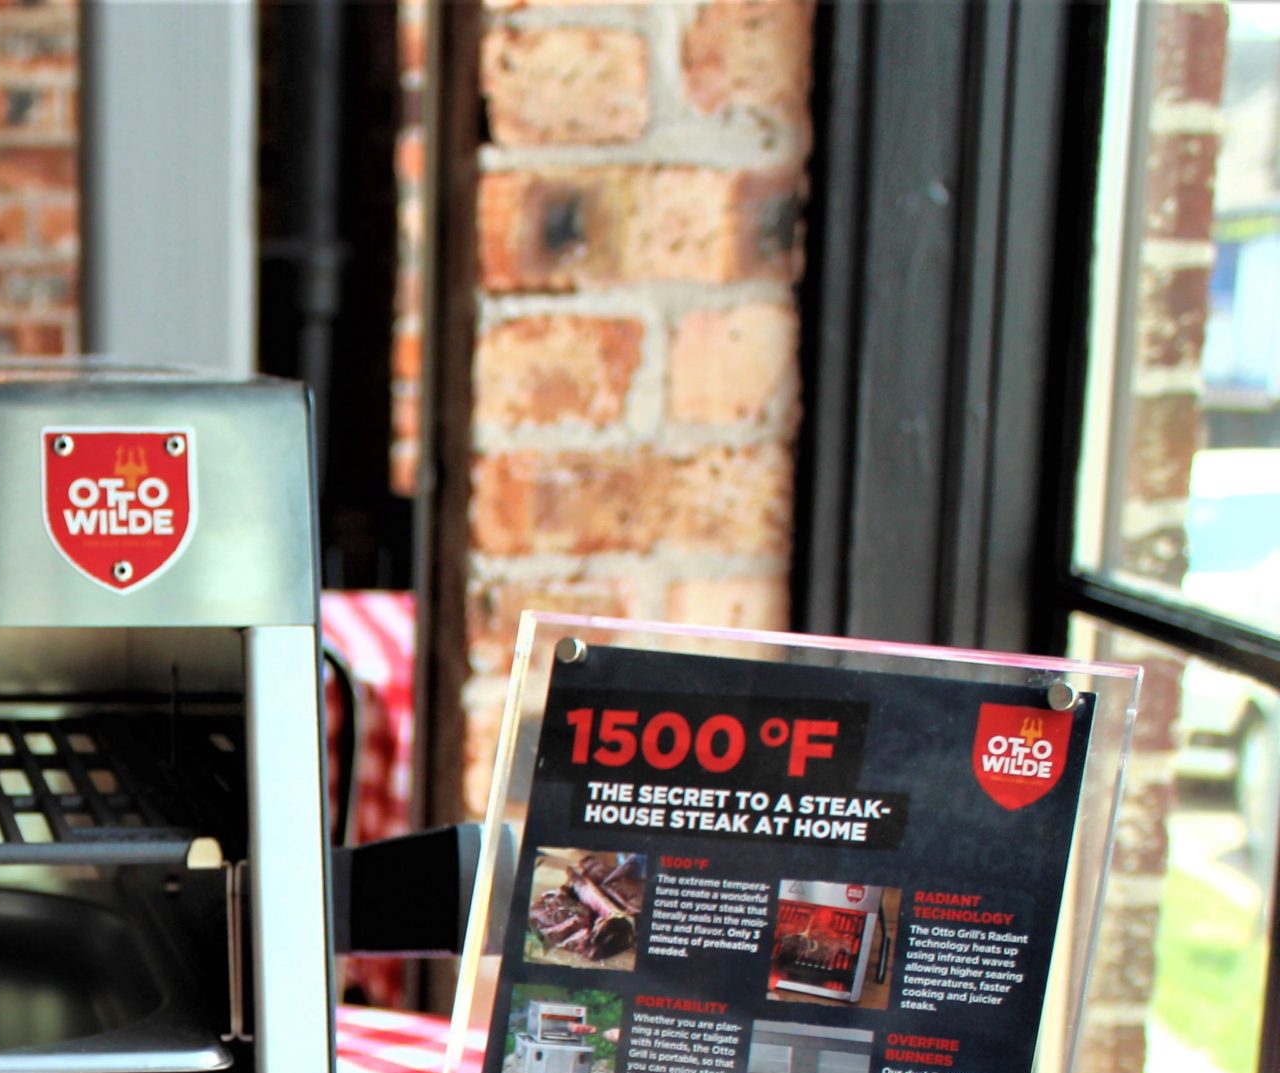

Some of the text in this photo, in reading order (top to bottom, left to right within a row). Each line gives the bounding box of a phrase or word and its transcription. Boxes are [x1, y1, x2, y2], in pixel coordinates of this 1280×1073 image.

[68, 477, 169, 520] OTTO
[63, 509, 174, 535] WILDE
[567, 708, 746, 773] 1500
[987, 735, 1053, 766] OTTO
[982, 755, 1053, 778] WILDE
[588, 782, 892, 819] THE SECRET TO A STEAK-
[584, 804, 868, 842] HOUSE STEAK AT HOME
[657, 873, 770, 891] The extreme tempera-
[656, 886, 679, 896] tures
[681, 888, 710, 898] create
[720, 892, 768, 903] wonderful
[915, 891, 981, 906] RADIANT
[654, 899, 678, 908] crust
[694, 903, 717, 912] your
[719, 904, 744, 914] steak
[747, 906, 768, 916] that
[913, 906, 1014, 925] TECHNOLOGY
[652, 910, 687, 922] literally
[688, 914, 711, 923] seals
[713, 915, 722, 924] in
[724, 916, 739, 925] the
[651, 922, 671, 932] ture
[673, 924, 692, 933] and
[727, 928, 751, 940] Only
[752, 930, 760, 939] 3
[910, 925, 929, 935] The
[931, 927, 955, 937] Otto
[988, 932, 1028, 943] Radiant
[648, 946, 688, 957] needed.
[650, 934, 758, 952] minutes of preheating
[908, 938, 1018, 956] Technology heats up
[906, 951, 1015, 968] using infrared waves
[905, 962, 1023, 982] allowing higher searing
[904, 975, 1011, 992] temperatures, faster
[635, 995, 727, 1014] PORTABILITY
[902, 988, 1002, 1004] cooking and juicier
[900, 1000, 937, 1011] steaks.
[633, 1013, 675, 1025] Whether
[677, 1019, 695, 1027] you
[716, 1022, 742, 1032] plan-
[631, 1026, 652, 1036] ning
[661, 1029, 689, 1039] picnic
[703, 1033, 739, 1044] tailgate
[887, 1033, 959, 1051] OVERFIRE
[630, 1038, 735, 1056] with friends, the Otto
[629, 1049, 648, 1058] Grill
[649, 1051, 656, 1059] is
[658, 1053, 700, 1065] portable,
[715, 1059, 734, 1068] that
[885, 1049, 953, 1066] BURNERS
[627, 1062, 646, 1071] you
[648, 1064, 666, 1072] can
